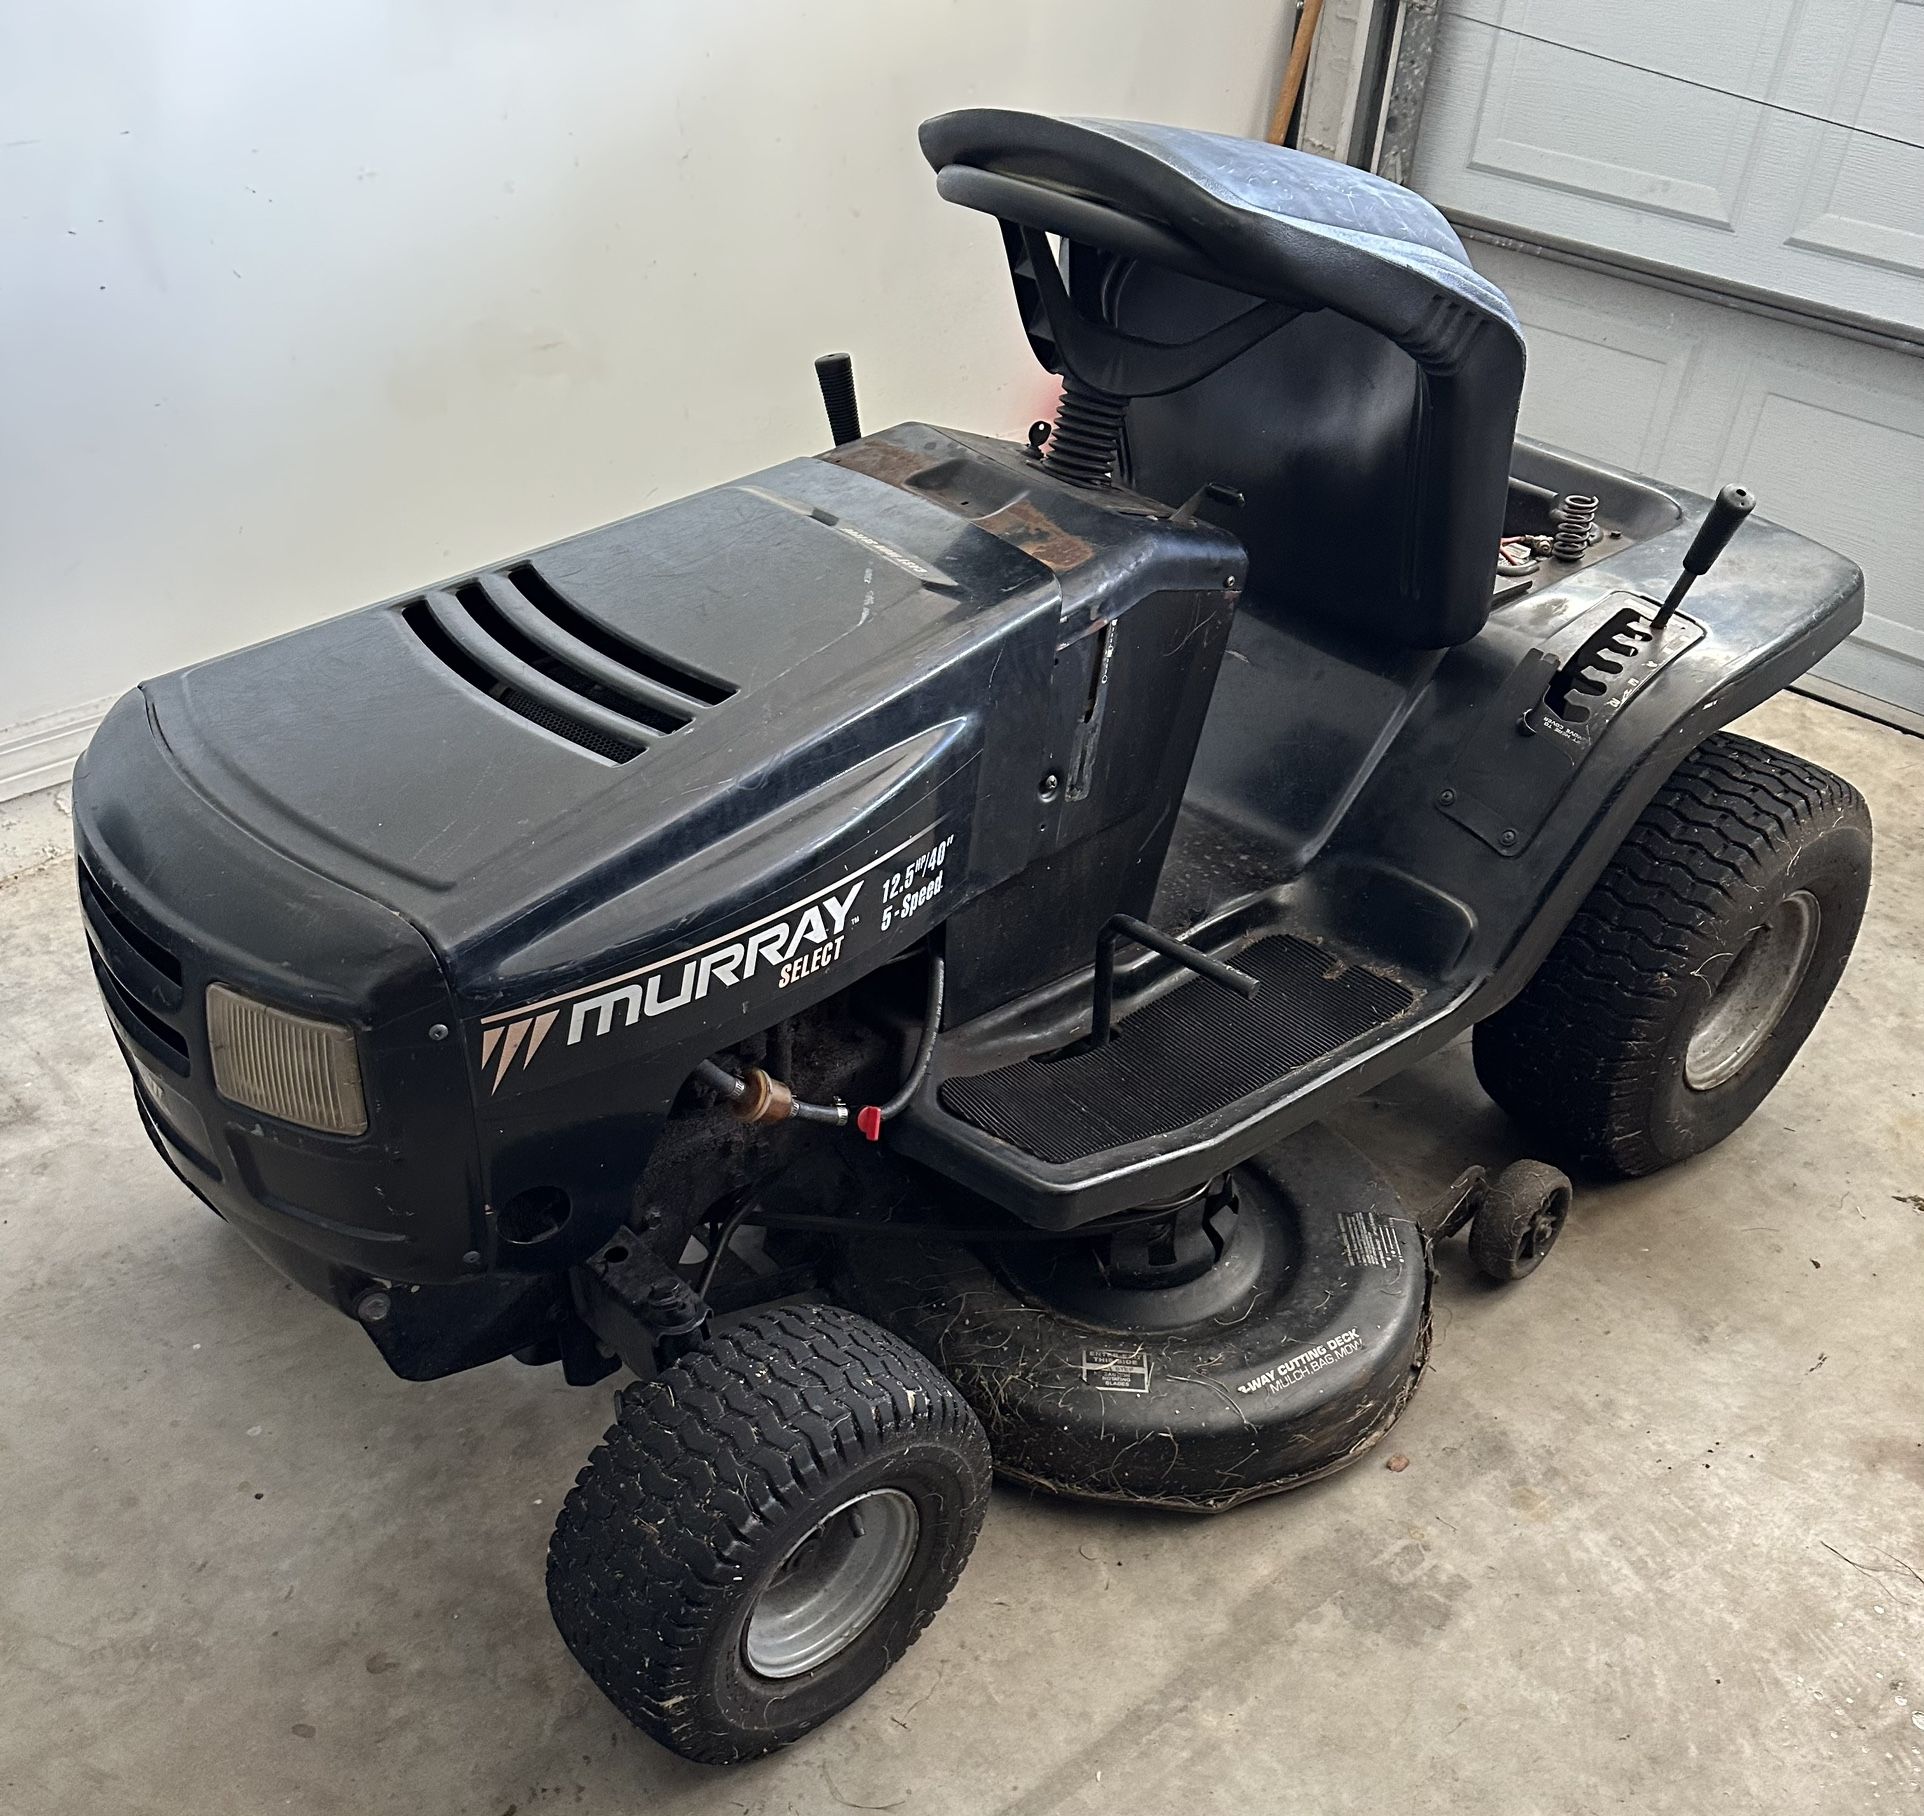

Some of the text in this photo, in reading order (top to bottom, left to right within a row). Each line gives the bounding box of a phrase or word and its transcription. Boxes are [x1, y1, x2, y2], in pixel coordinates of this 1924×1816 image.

[1543, 716, 1564, 730] COVER
[881, 869, 943, 931] 5-Speed
[567, 880, 864, 1046] MURRAY
[778, 935, 844, 989] SELECT
[1276, 1345, 1327, 1376] CUTTING
[1326, 1328, 1360, 1350] DECK
